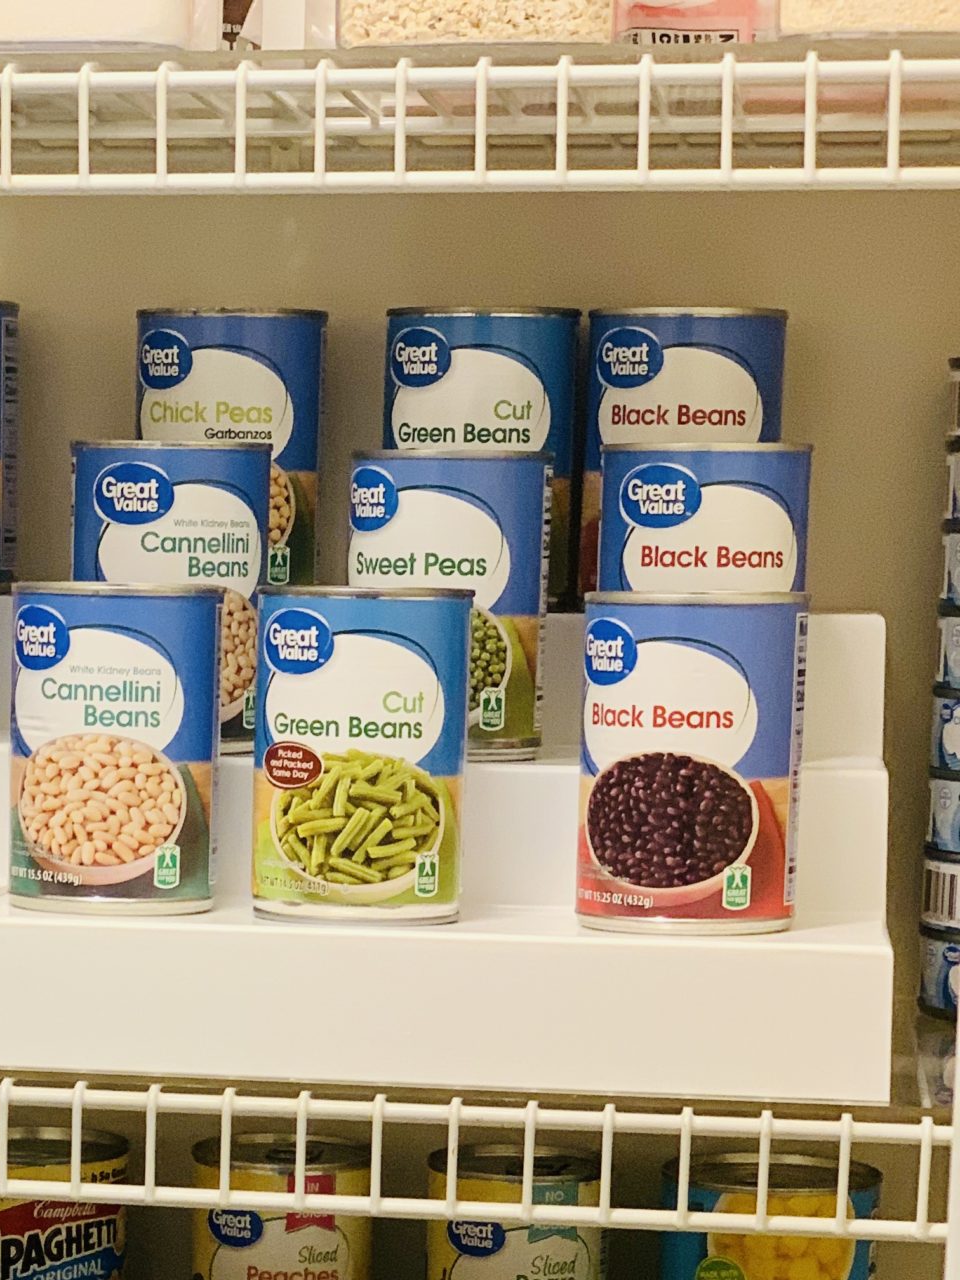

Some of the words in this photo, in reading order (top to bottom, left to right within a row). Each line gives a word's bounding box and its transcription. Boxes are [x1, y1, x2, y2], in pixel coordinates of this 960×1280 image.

[150, 402, 206, 424] Chick
[215, 402, 273, 424] Peas
[493, 400, 532, 420] Cut
[611, 405, 669, 426] Black
[678, 405, 746, 426] Beans
[204, 427, 272, 440] Garbanzos
[398, 423, 455, 443] Green
[463, 423, 531, 443] Beans
[102, 477, 159, 499] Great
[627, 479, 685, 502] Great
[113, 497, 158, 513] Value
[639, 499, 684, 516] Value
[140, 531, 249, 553] Cannellini
[188, 556, 248, 578] Beans
[356, 552, 417, 577] Sweet
[424, 553, 487, 576] Peas
[640, 545, 708, 569] Black
[716, 546, 784, 569] Beans
[16, 620, 56, 645] Great
[269, 623, 319, 648] Great
[23, 642, 56, 658] Value
[278, 644, 318, 662] Value
[586, 632, 624, 657] Great
[592, 655, 623, 673] Value
[40, 678, 161, 703] Cannellini
[382, 691, 425, 713] Cut
[83, 704, 161, 728] Beans
[592, 702, 644, 729] Black
[653, 705, 733, 729] Beans
[274, 714, 340, 739] Green
[348, 715, 423, 740] Beans
[278, 749, 303, 759] Picked
[283, 759, 313, 769] Packed
[273, 768, 291, 778] Same
[292, 769, 309, 780] Day
